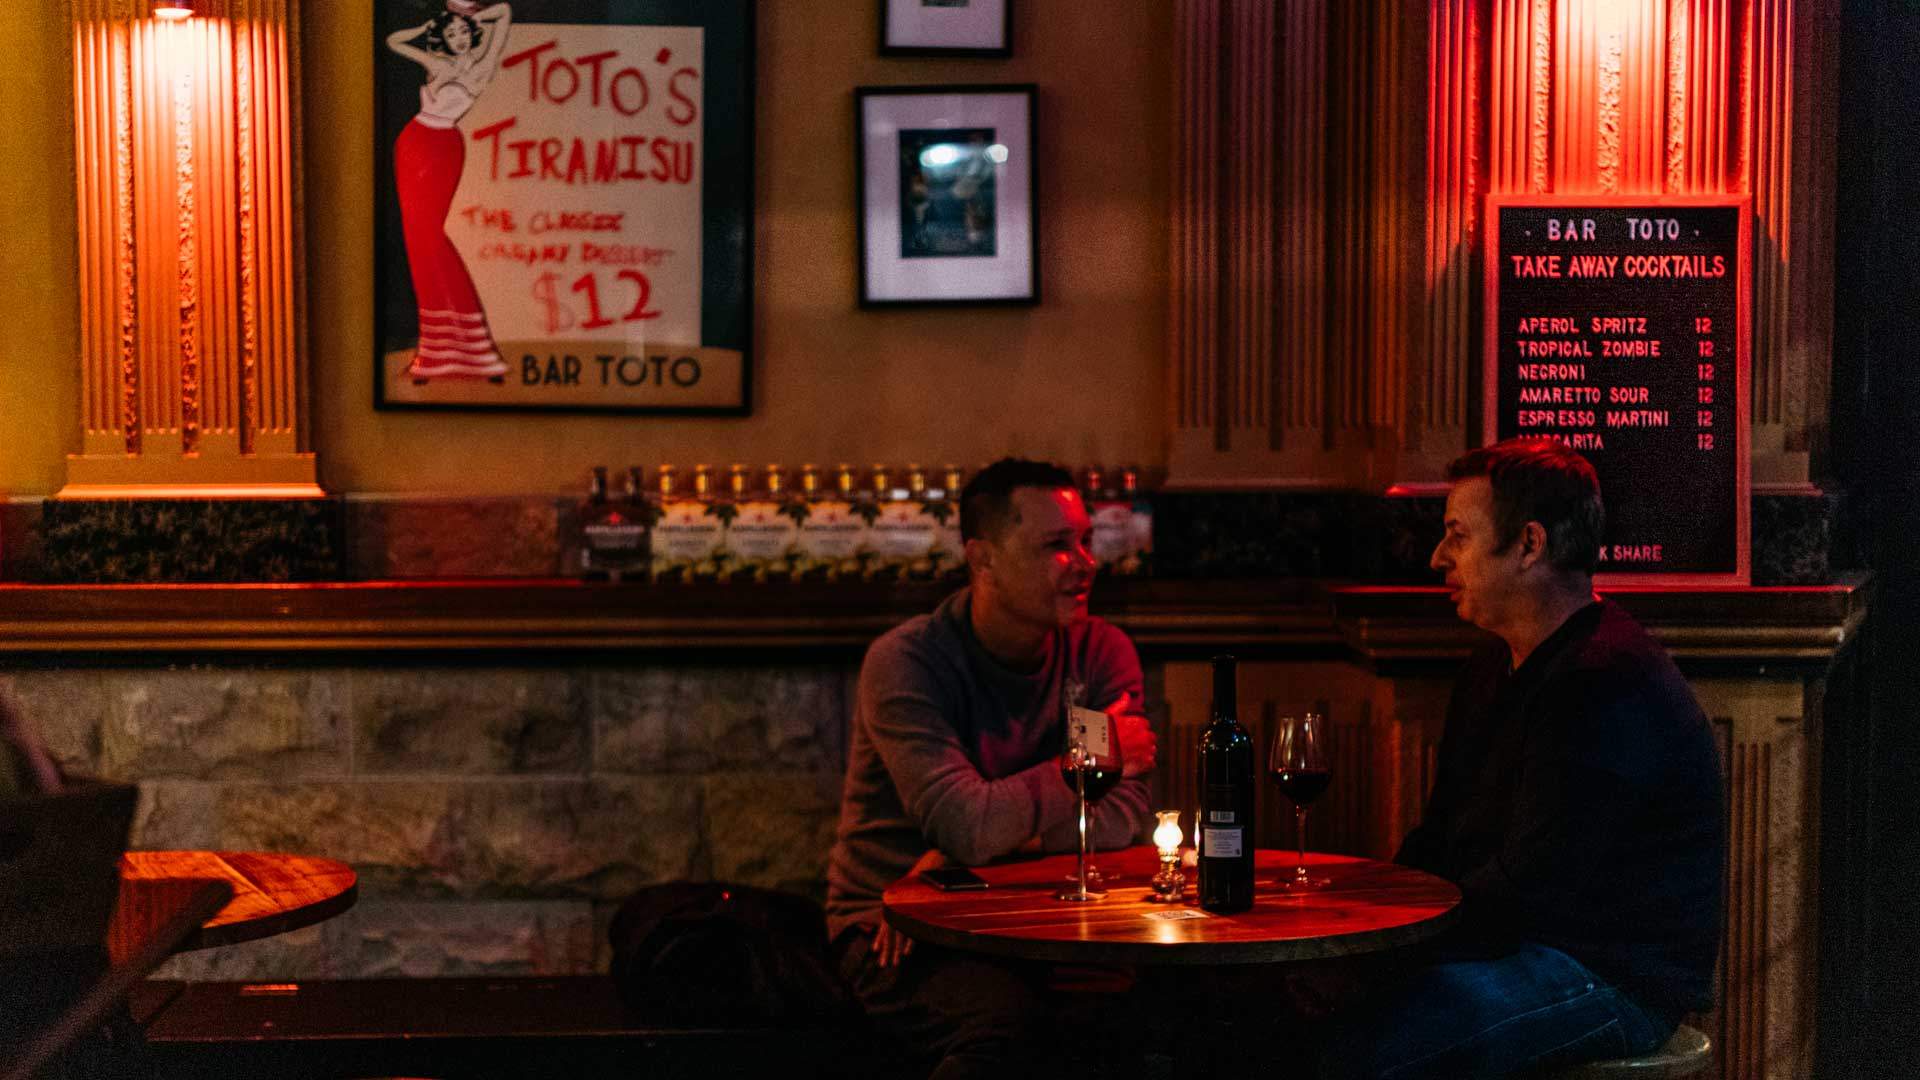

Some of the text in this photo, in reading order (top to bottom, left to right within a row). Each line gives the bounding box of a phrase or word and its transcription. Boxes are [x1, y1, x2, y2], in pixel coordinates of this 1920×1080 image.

[502, 40, 699, 126] TOTO'S
[461, 206, 515, 232] THE
[1546, 218, 1680, 241] BAR TOTO
[1511, 255, 1726, 278] TAKE AWAY COCKTAILS
[532, 268, 663, 334] $12
[1518, 317, 1713, 334] APEROL SPRITZ 12
[1517, 340, 1714, 358] TROPICAL ZOMBIE 12
[522, 354, 701, 388] BAR TOTO
[1518, 364, 1714, 380] NEGRONI 12
[1519, 387, 1714, 404] AMARETTO SOUR 12
[1518, 410, 1713, 428] ESPRESSO MARTINI 12
[1518, 433, 1714, 451] ARITA 12
[1613, 545, 1663, 562] SHARE
